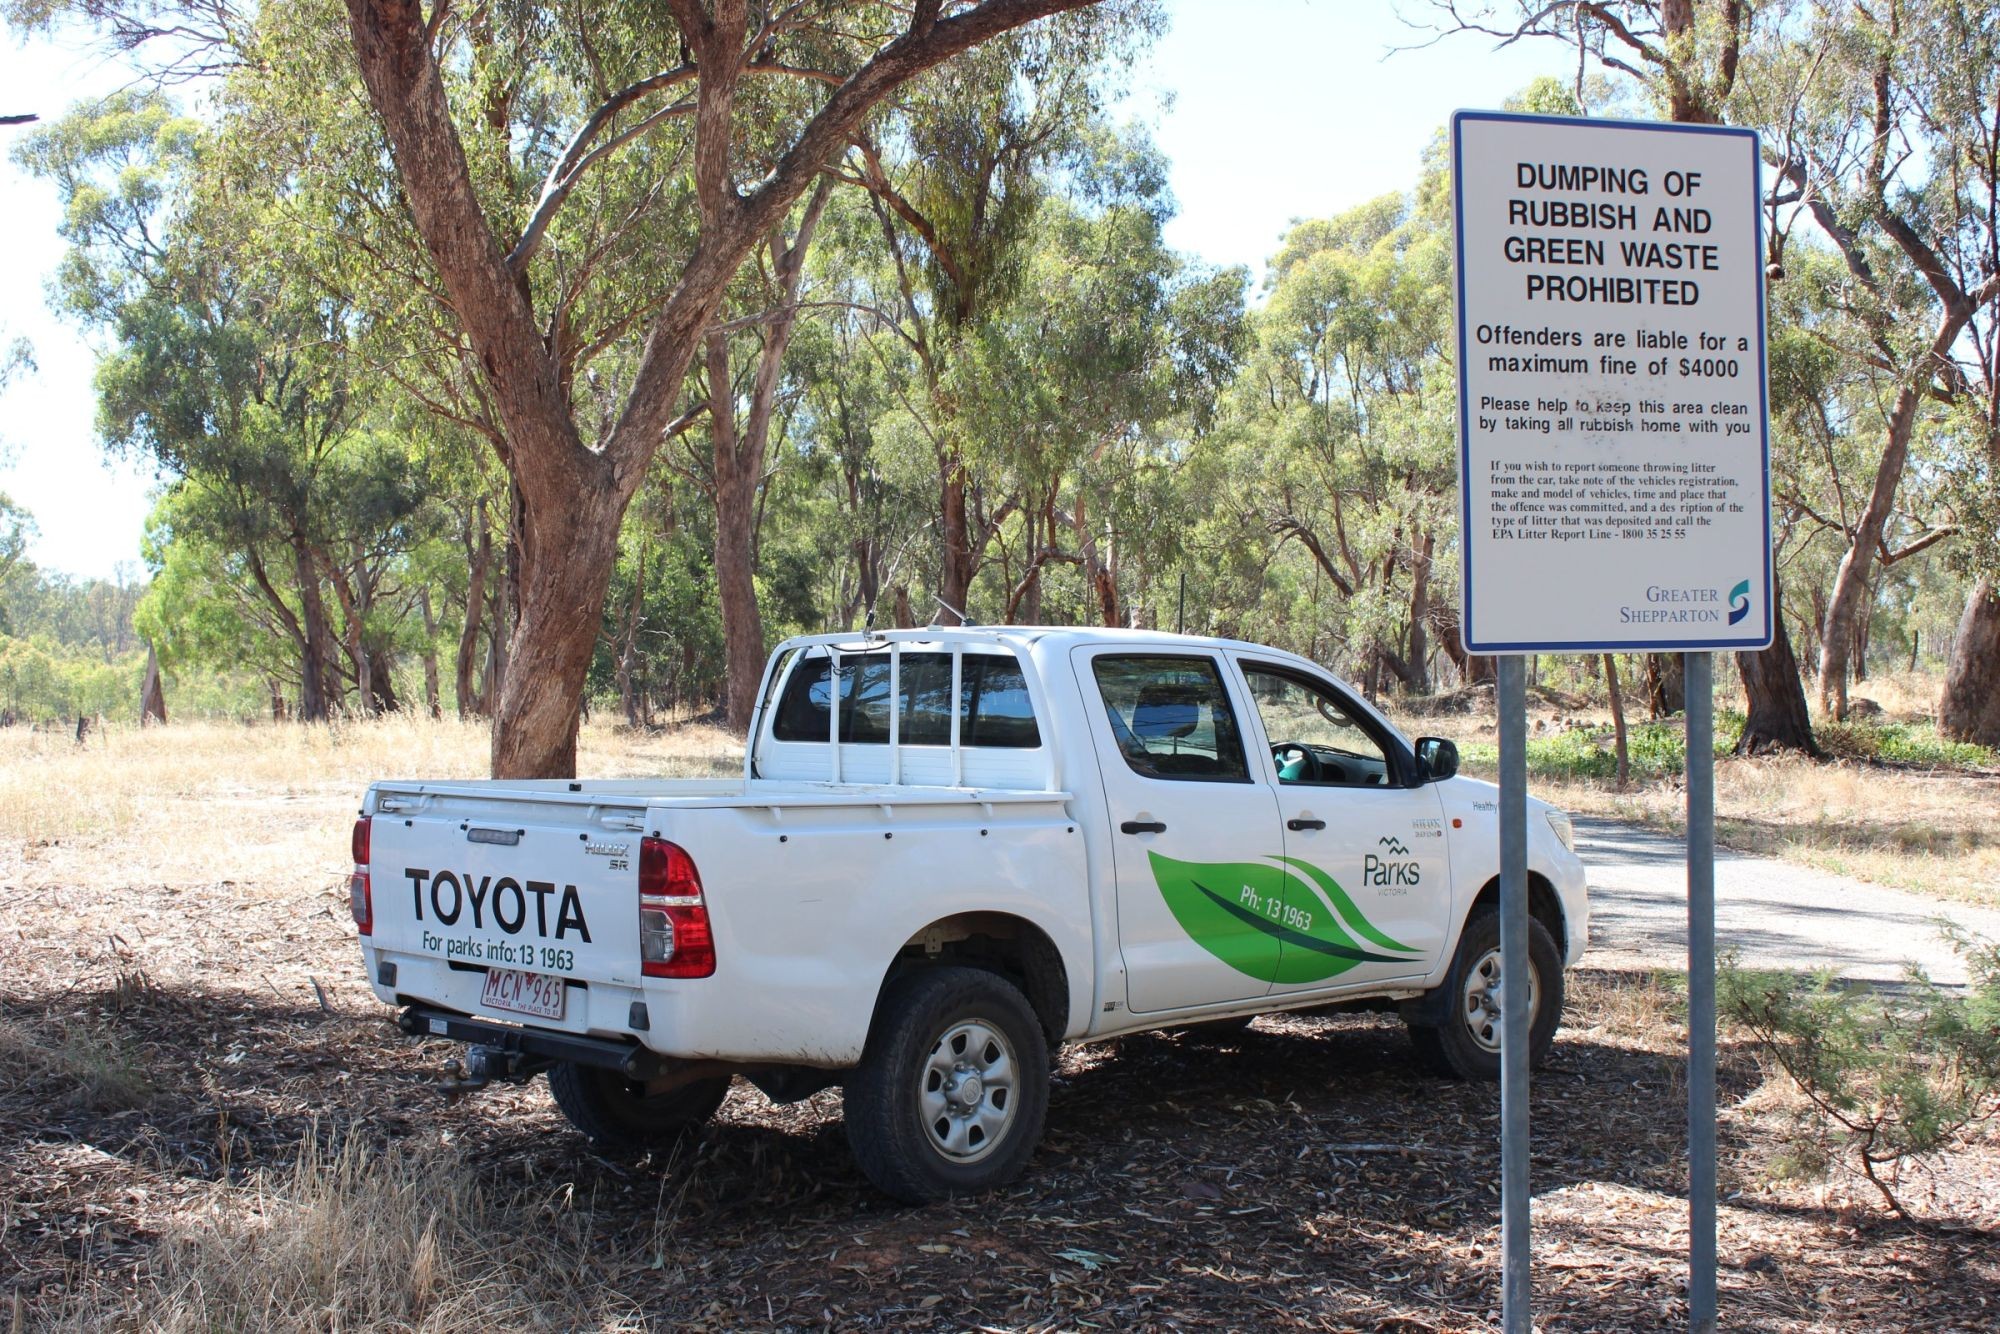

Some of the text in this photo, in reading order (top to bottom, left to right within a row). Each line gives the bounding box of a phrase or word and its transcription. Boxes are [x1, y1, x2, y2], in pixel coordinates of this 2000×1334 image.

[1517, 163, 1701, 197] DUMPING OF
[1509, 200, 1712, 234] RUBBISH AND
[1504, 236, 1719, 270] GREEN WASTE
[1527, 274, 1699, 306] PROHIBITED
[1476, 324, 1748, 351] Offenders are liable for a
[1489, 354, 1739, 377] maximum fine of $4000
[1480, 396, 1748, 416] Please help to keep this area clean
[1479, 416, 1750, 437] by taking all rubbish home with you
[1490, 461, 1716, 475] If you wish to report someone throwing litter
[1491, 475, 1739, 487] from the car, take note of the vehicles registration,
[1491, 488, 1727, 502] make and model of vehicles, time and place that
[1491, 502, 1744, 515] the offence was committed, and a desription of the
[1491, 516, 1712, 528] type of litter that was deposited and call the
[1492, 529, 1514, 539] EPA
[1518, 529, 1547, 539] Litter
[1551, 529, 1586, 541] Report
[1589, 529, 1612, 539] Line
[1622, 529, 1644, 539] 1800
[1646, 529, 1658, 539] 35
[1661, 529, 1672, 539] 25
[1674, 529, 1686, 539] 55
[1646, 586, 1718, 602] GREATER
[1620, 607, 1719, 623] SHEPPARTON
[1473, 801, 1497, 814] Healthy
[585, 842, 630, 857] HILUX
[609, 860, 629, 871] SR
[1363, 854, 1420, 886] Parks
[1378, 888, 1408, 897] VICTORIA
[405, 868, 592, 944] TOYOTA
[1240, 884, 1312, 931] Ph: 13 1963
[423, 930, 574, 971] For parks info: 13 1963
[486, 970, 561, 1008] MCN 965
[486, 997, 511, 1008] VICTORIA
[544, 1007, 553, 1015] TO
